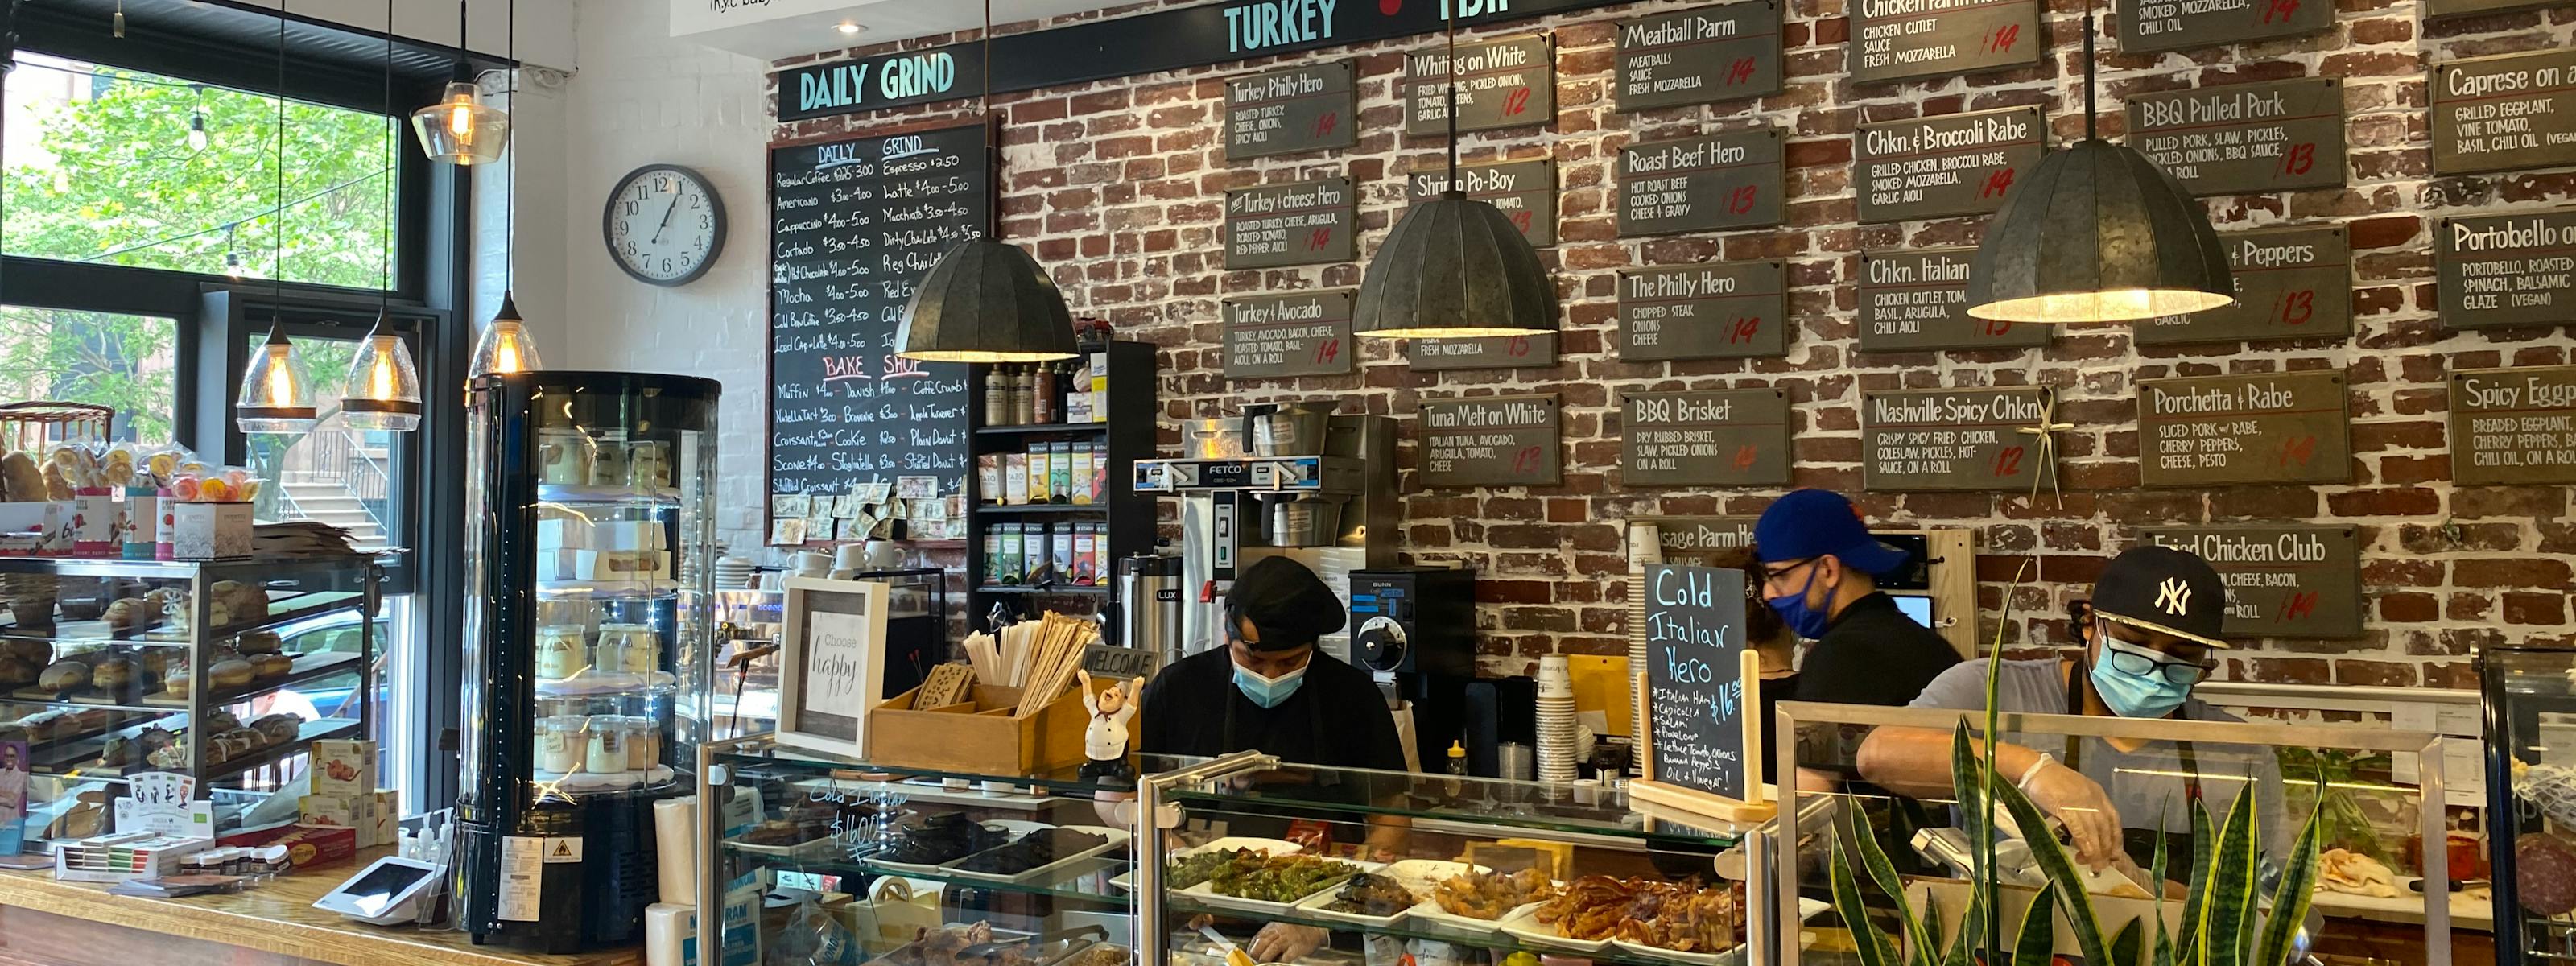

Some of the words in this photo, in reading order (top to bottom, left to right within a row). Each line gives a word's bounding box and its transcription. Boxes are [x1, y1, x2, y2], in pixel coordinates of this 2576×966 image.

[1863, 0, 1925, 18] Chicken
[1224, 0, 1336, 52] TURKEY
[1624, 18, 1691, 49] Meatball
[1696, 15, 1736, 39] Parm
[1864, 23, 1901, 39] CHICKEN
[1906, 19, 1938, 35] CUTLET
[2139, 20, 2162, 35] CHILI
[2167, 18, 2183, 32] OIL
[1864, 39, 1891, 54] SAUCE
[1468, 56, 1483, 71] on
[1486, 45, 1527, 68] White
[1629, 52, 1672, 68] MEATBALLS
[1864, 54, 1890, 68] FRESH
[1895, 45, 1956, 64] MOZZARELLA
[800, 63, 869, 111] DAILY
[881, 52, 954, 100] GRIND
[1629, 67, 1652, 81] SAUCE
[2449, 68, 2529, 97] Caprese
[2536, 67, 2559, 87] on
[1233, 82, 1265, 103] Turkey
[1269, 76, 1298, 98] Philly
[1300, 73, 1323, 93] Hero
[1470, 78, 1496, 90] PICKLED
[1629, 79, 1651, 95] FRESH
[1653, 76, 1702, 93] MOZZARELLA
[1235, 109, 1259, 122] ROASTED
[2143, 98, 2184, 127] BBQ
[2190, 93, 2240, 122] Pulled
[2248, 91, 2285, 118] Pork
[2455, 105, 2496, 121] GRILLED
[2500, 98, 2554, 117] EGGPLANT,
[1866, 129, 1911, 155] Chkn.
[1923, 122, 1984, 150] Broccoli
[1988, 116, 2028, 141] Rabe
[2457, 122, 2481, 137] VINE
[2486, 118, 2531, 134] TOMATO,
[818, 143, 855, 163] DAILY
[882, 136, 922, 155] GRIND
[2146, 136, 2179, 151] PULLED
[2492, 136, 2517, 151] CHILI
[2521, 134, 2538, 148] OIL
[1629, 148, 1667, 174] Roast
[1671, 145, 1705, 170] Beef
[1710, 142, 1745, 166] Hero
[2226, 147, 2247, 160] BBQ
[883, 160, 927, 175] Espresso
[1872, 161, 1901, 177] GRILLED
[1942, 154, 1979, 171] BROCCOLI
[653, 177, 667, 192] 12
[678, 180, 683, 195] 1
[1467, 169, 1515, 192] Po-Boy
[1630, 181, 1645, 195] HOT
[1647, 178, 1670, 193] ROAST
[1671, 175, 1688, 191] BEEF
[638, 185, 650, 200] 11
[1243, 192, 1275, 213] Turkey
[1283, 188, 1315, 208] cheese
[1318, 185, 1340, 205] Hero
[1630, 194, 1657, 207] COOKED
[1658, 192, 1686, 205] ONIONS
[1872, 190, 1901, 206] GARLIC
[1902, 188, 1923, 204] AIOLI
[625, 200, 639, 216] 10
[690, 194, 700, 209] 2
[1665, 203, 1691, 219] GRAVY
[620, 221, 629, 236] 9
[700, 215, 708, 229] 3
[694, 235, 702, 250] 4
[2454, 219, 2557, 251] Portobello
[628, 241, 637, 255] 8
[777, 242, 814, 258] Cortado
[2244, 240, 2314, 267] Peppers
[642, 254, 650, 268] 7
[663, 258, 671, 273] 6
[681, 252, 689, 266] 5
[2462, 260, 2524, 277] PORTOBELLO,
[2529, 257, 2574, 273] ROASTED
[1870, 260, 1916, 284] Chkn.
[1922, 258, 1971, 283] Italian
[883, 281, 900, 299] Red
[1630, 274, 1654, 299] The
[1657, 272, 1697, 299] Philly
[1700, 270, 1736, 295] Hero
[2463, 277, 2512, 293] SPINACH,
[2516, 274, 2570, 291] BALSAMIC
[778, 287, 813, 304] Mocha
[2463, 295, 2498, 310] GLAZE
[2512, 292, 2551, 308] (VEGAN)
[1233, 302, 1269, 324] Turkey
[1277, 298, 1322, 320] Avocado
[1633, 307, 1666, 320] CHOPPED
[1671, 303, 1694, 317] STEAK
[1633, 320, 1661, 332] ONIONS
[1633, 332, 1658, 347] CHEESE
[1421, 344, 1439, 357] FRESH
[1442, 342, 1483, 356] MOZZARELLA
[824, 356, 864, 375] BAKE
[2154, 387, 2232, 415] Porchetta
[2248, 382, 2293, 409] Rabe
[2465, 378, 2520, 409] Spicy
[1425, 406, 1455, 427] Tuna
[1457, 404, 1487, 427] Melt
[1488, 408, 1503, 425] on
[1505, 402, 1546, 426] White
[1636, 398, 1671, 423] BBQ
[1677, 398, 1732, 423] Brisket
[1875, 398, 1942, 423] Nashville
[1945, 396, 1988, 423] Spicy
[1992, 394, 2041, 422] Chkn.
[2159, 423, 2188, 439] SLICED
[2190, 422, 2216, 437] PORK
[2472, 419, 2518, 433] BREADED
[1430, 435, 1454, 448] ITALIAN
[1637, 431, 1653, 445] DRY
[1654, 431, 1682, 444] RUBBED
[1877, 431, 1905, 447] CRISPY
[1908, 431, 1930, 446] SPICY
[1933, 430, 1957, 445] FRIED
[2159, 438, 2194, 454] CHERRY
[2473, 436, 2513, 449] CHERRY
[1430, 460, 1452, 473] CHEESE
[1657, 456, 1677, 471] ROLL
[2198, 452, 2227, 469] PESTO
[2474, 452, 2500, 466] CHILI
[2527, 451, 2542, 465] ON
[1209, 464, 1242, 474] FETCO
[2203, 534, 2273, 562] Chicken
[2277, 533, 2326, 562] Club
[1656, 569, 1712, 608] Cold
[2236, 605, 2260, 618] ROLL
[1649, 611, 1728, 648] Italian
[825, 634, 857, 648] Choose
[812, 635, 857, 699] happy
[1085, 650, 1151, 676] WELCOME
[1666, 646, 1711, 683] Hero
[810, 782, 844, 803] Cold
